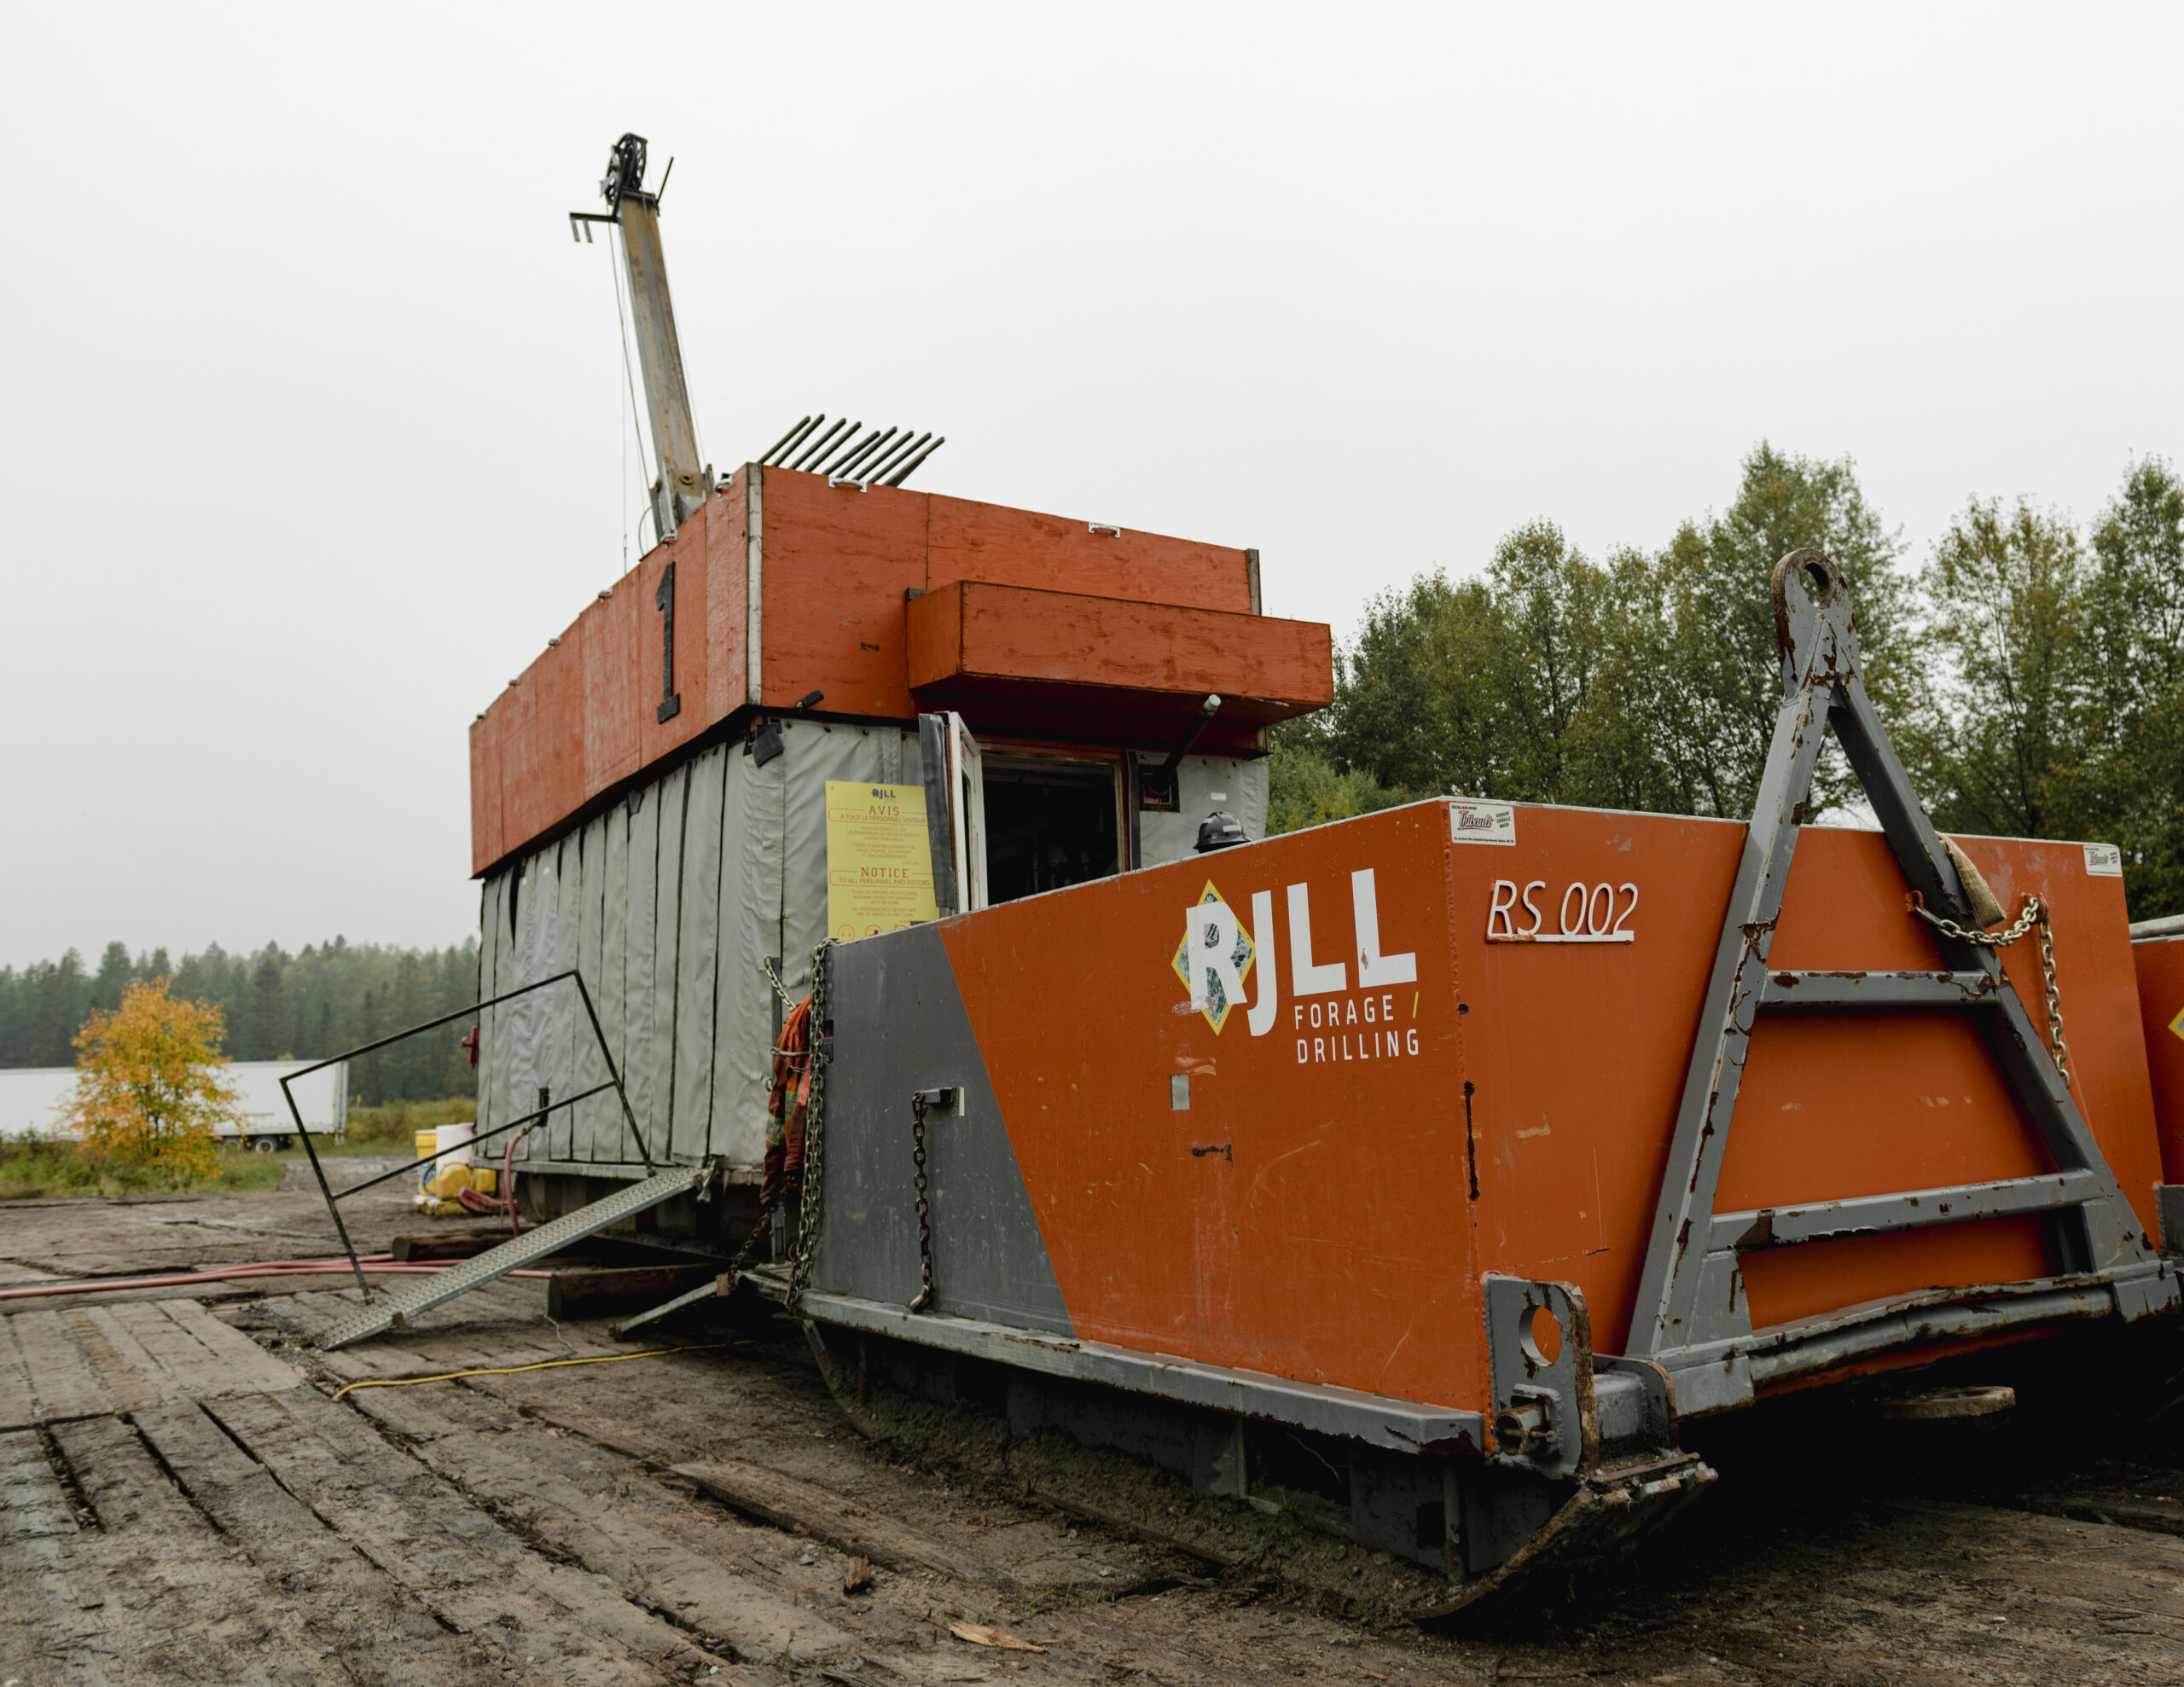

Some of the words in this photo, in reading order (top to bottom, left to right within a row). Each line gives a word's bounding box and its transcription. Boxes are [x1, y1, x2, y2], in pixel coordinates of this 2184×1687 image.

[655, 561, 680, 725] 1
[868, 805, 899, 816] AVIS
[872, 788, 897, 799] RJLL
[1458, 810, 1495, 828] Thibault
[861, 867, 909, 878] NOTICE
[1487, 879, 1546, 936] RS
[1560, 881, 1639, 936] 002
[1186, 867, 1417, 1037] RJLL
[1294, 994, 1394, 1030] FORAGE
[1297, 1029, 1420, 1064] DRILLING
